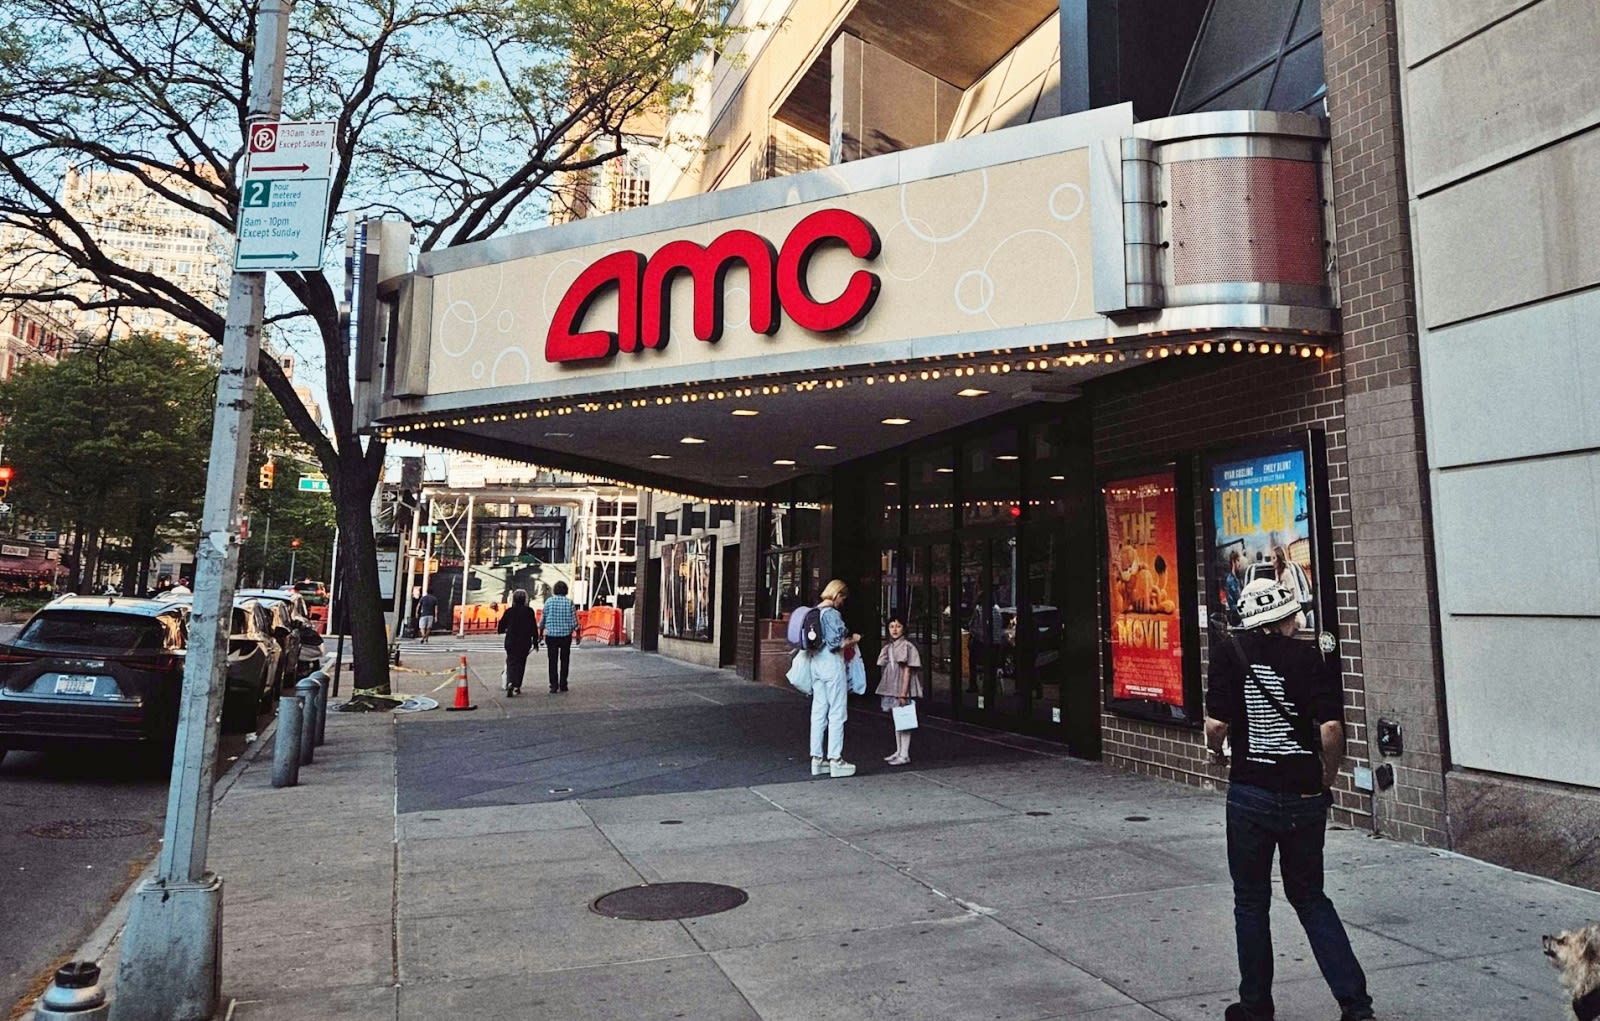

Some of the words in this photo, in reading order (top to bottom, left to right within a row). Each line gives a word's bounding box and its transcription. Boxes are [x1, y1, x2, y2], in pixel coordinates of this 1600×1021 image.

[279, 141, 302, 149] Except
[302, 140, 328, 149] Sunday
[273, 183, 289, 191] hour
[249, 182, 264, 206] 2
[272, 191, 302, 199] metered
[271, 200, 297, 208] parking
[244, 218, 262, 226] 8am
[269, 217, 290, 228] 10pm
[243, 228, 270, 238] Except
[272, 227, 302, 238] Sunday
[1222, 489, 1256, 537] FALL
[1260, 482, 1297, 534] GUY
[1119, 512, 1157, 545] THE
[1117, 618, 1169, 651] MOVIE
